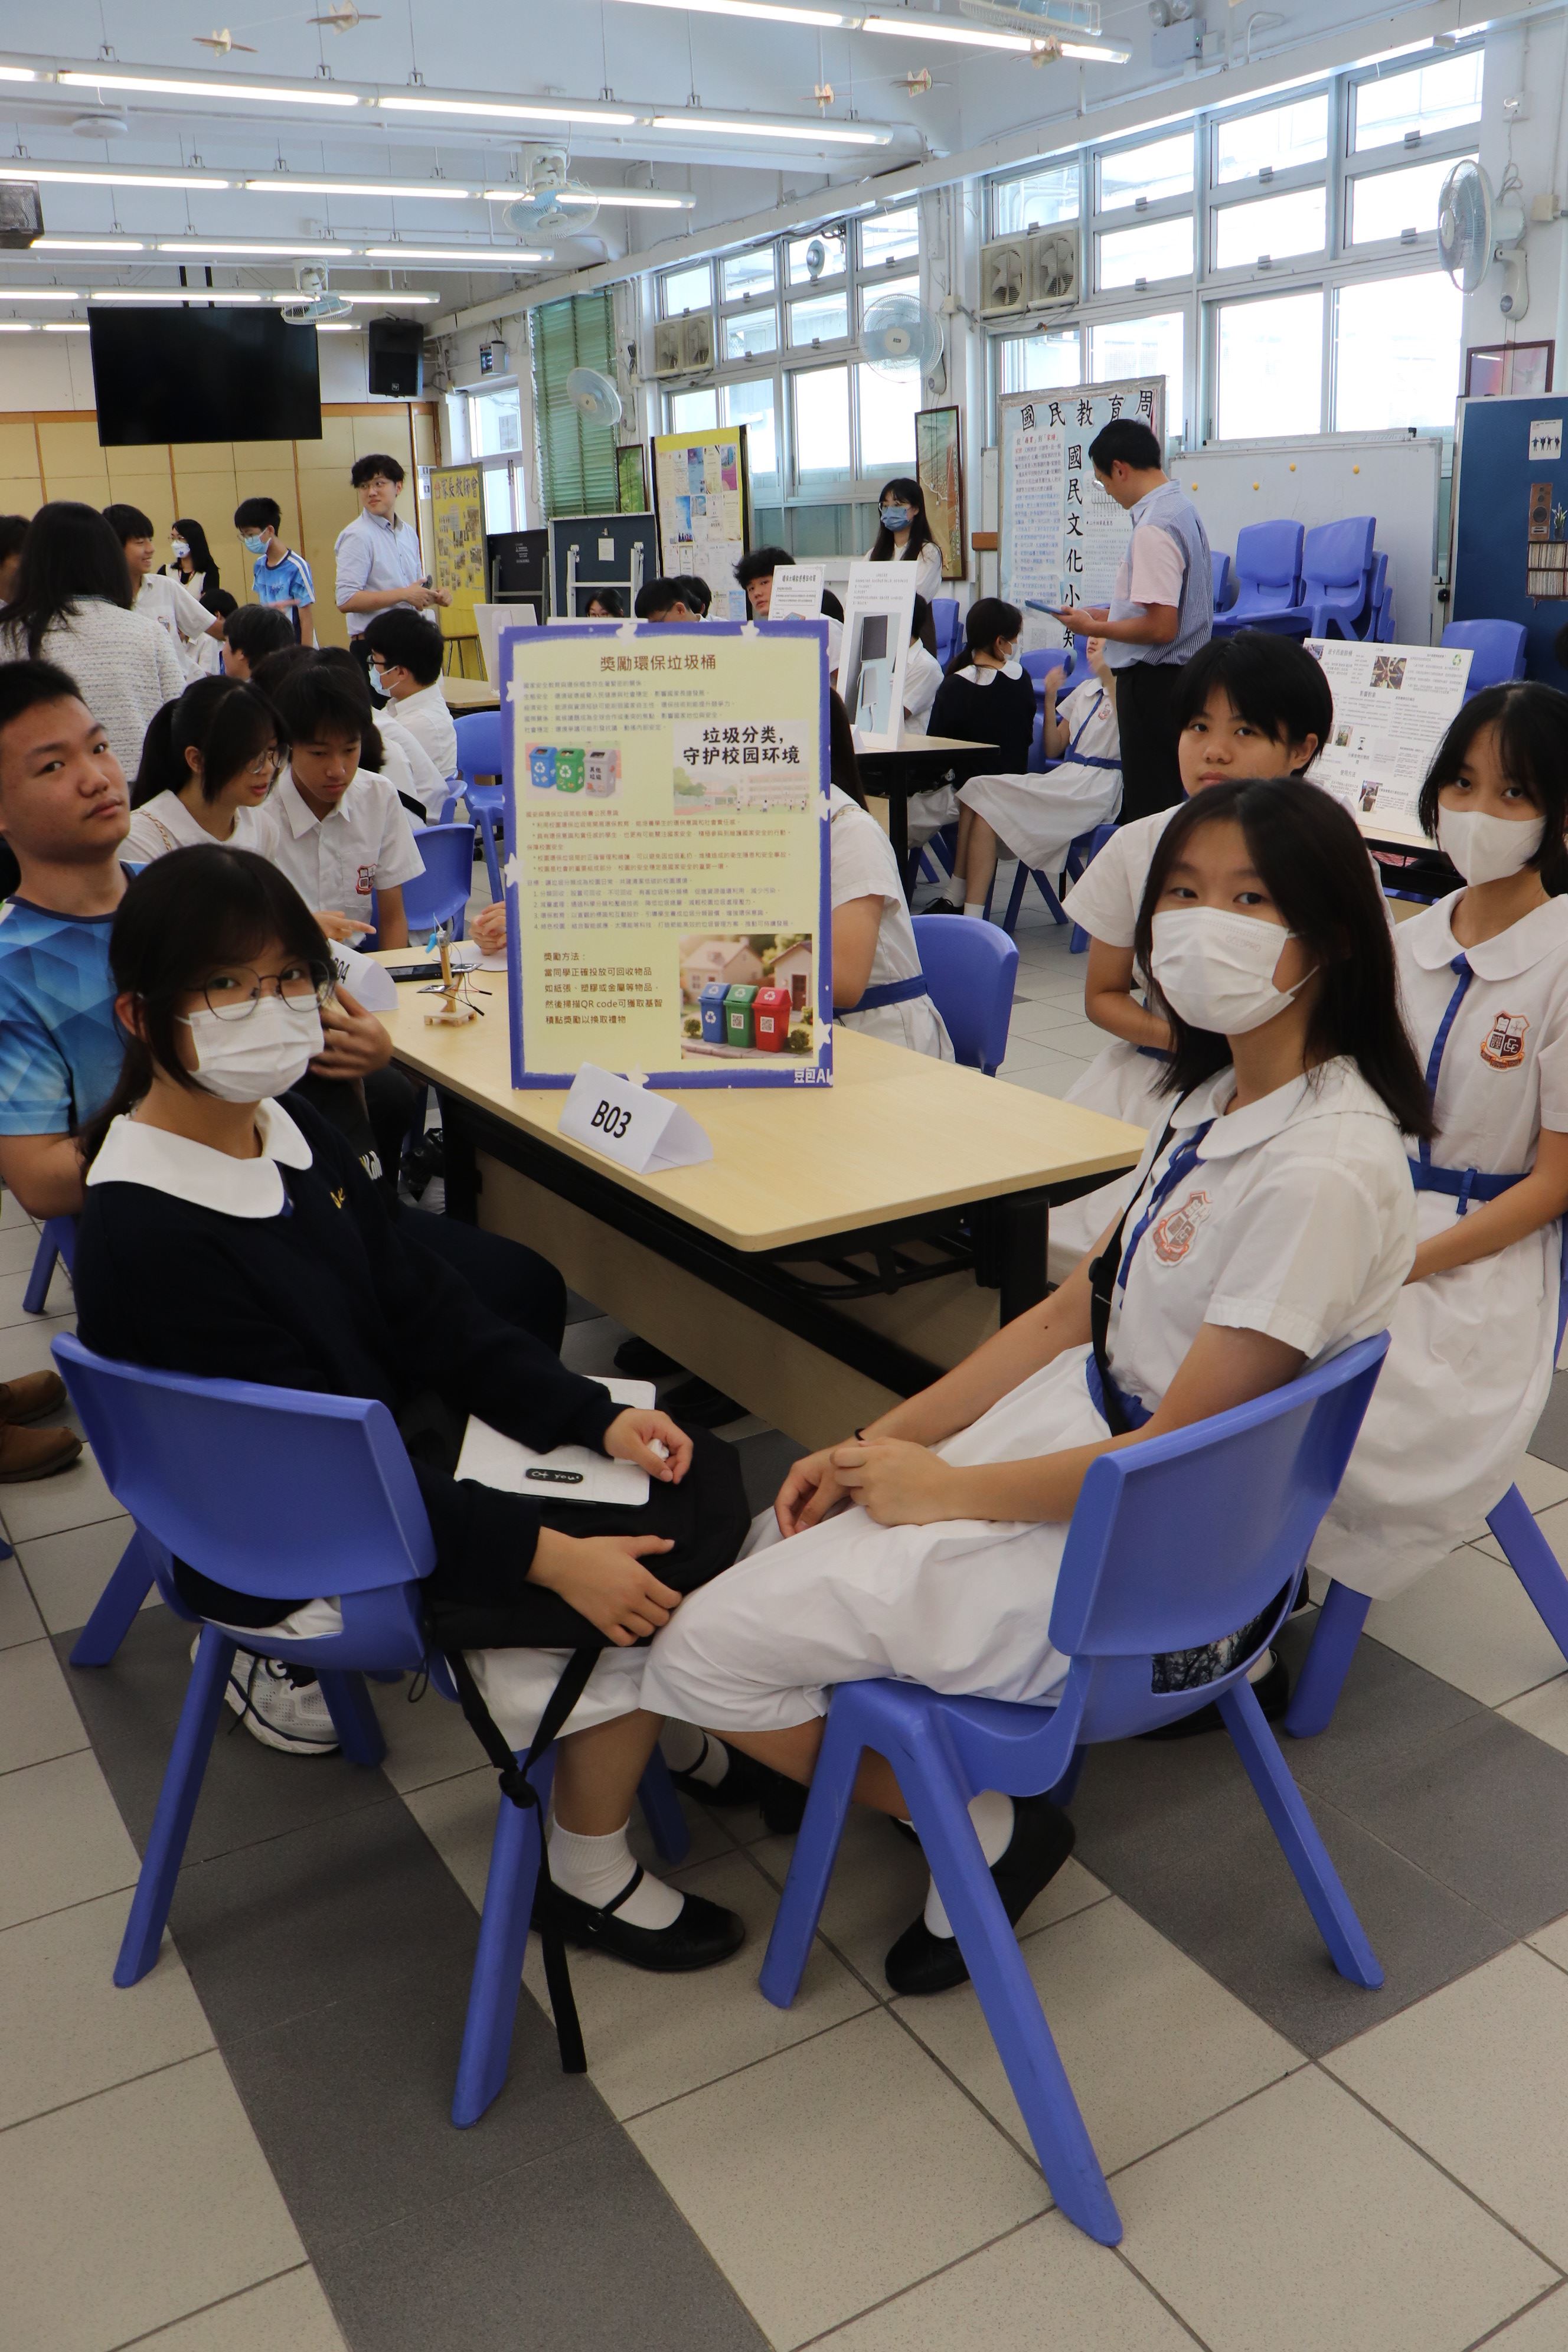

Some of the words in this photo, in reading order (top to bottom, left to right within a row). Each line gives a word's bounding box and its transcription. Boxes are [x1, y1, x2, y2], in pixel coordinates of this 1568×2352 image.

[600, 654, 716, 672] 獎勵環保垃圾桶
[682, 745, 801, 766] 守护校园环境
[544, 967, 652, 977] 當同學正確投放可回收物品
[545, 1015, 626, 1024] 積點獎勵以換取禮物
[590, 1100, 632, 1138] B03
